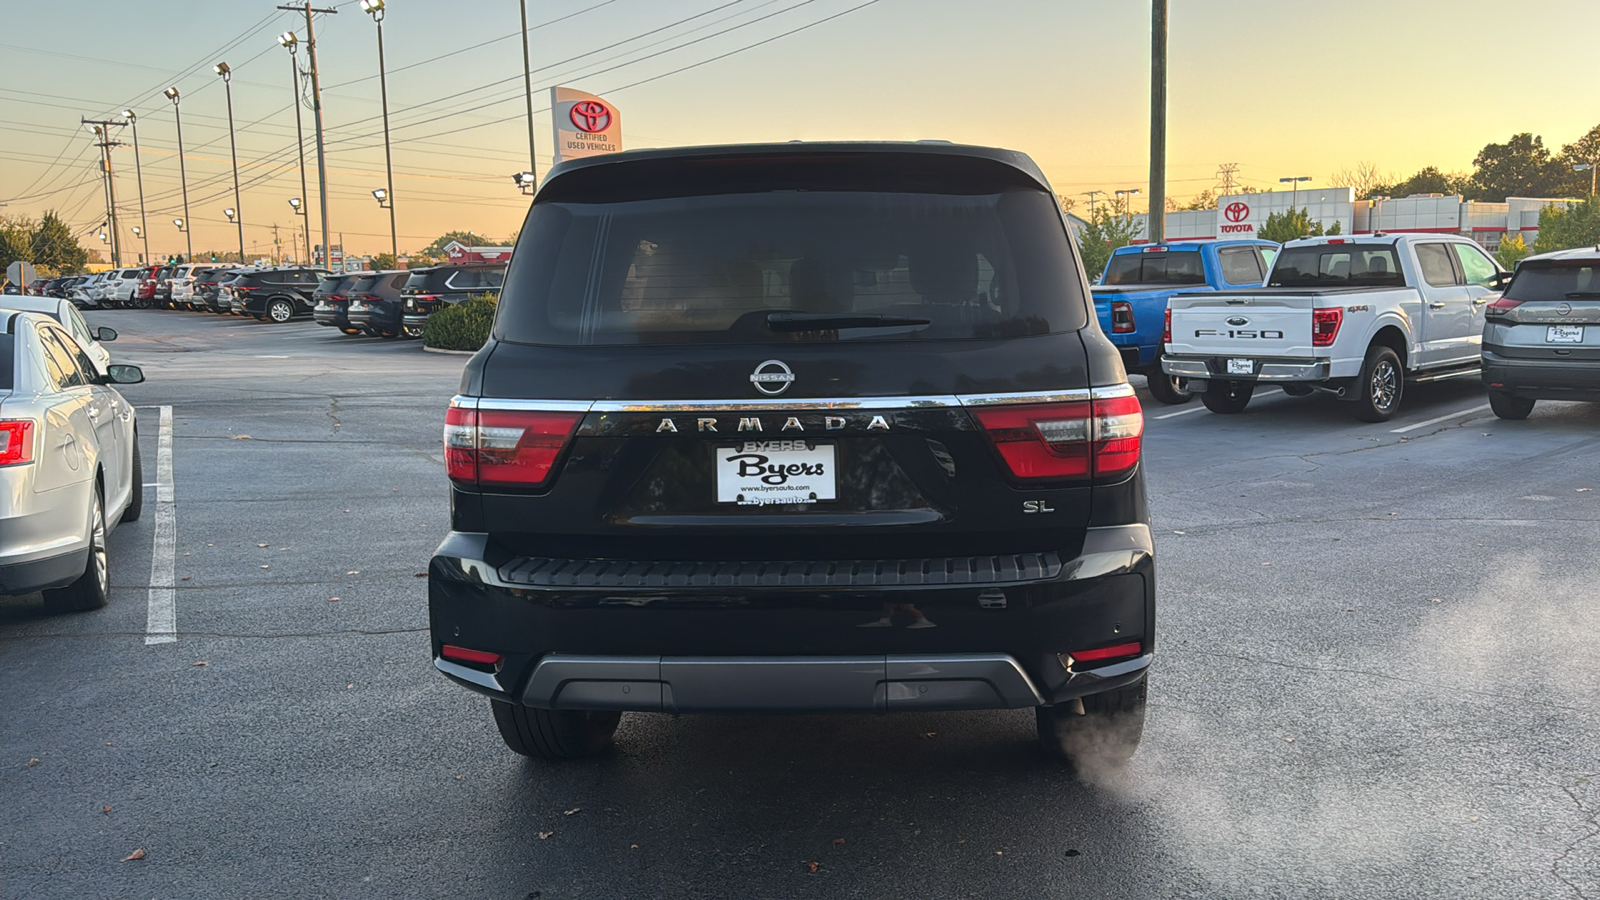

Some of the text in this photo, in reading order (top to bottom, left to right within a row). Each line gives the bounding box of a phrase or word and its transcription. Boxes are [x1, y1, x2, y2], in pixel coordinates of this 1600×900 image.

[576, 133, 607, 141] CERTIFIED
[567, 141, 615, 151] USED VEHICLES
[1220, 224, 1253, 233] TOYOTA
[1194, 329, 1284, 339] F-150
[751, 374, 795, 382] NISSAN
[656, 416, 890, 433] ARMADA
[743, 440, 807, 453] BYERS
[726, 454, 825, 485] Byers
[740, 484, 810, 492] www.byersauto.com
[1023, 500, 1055, 513] SL
